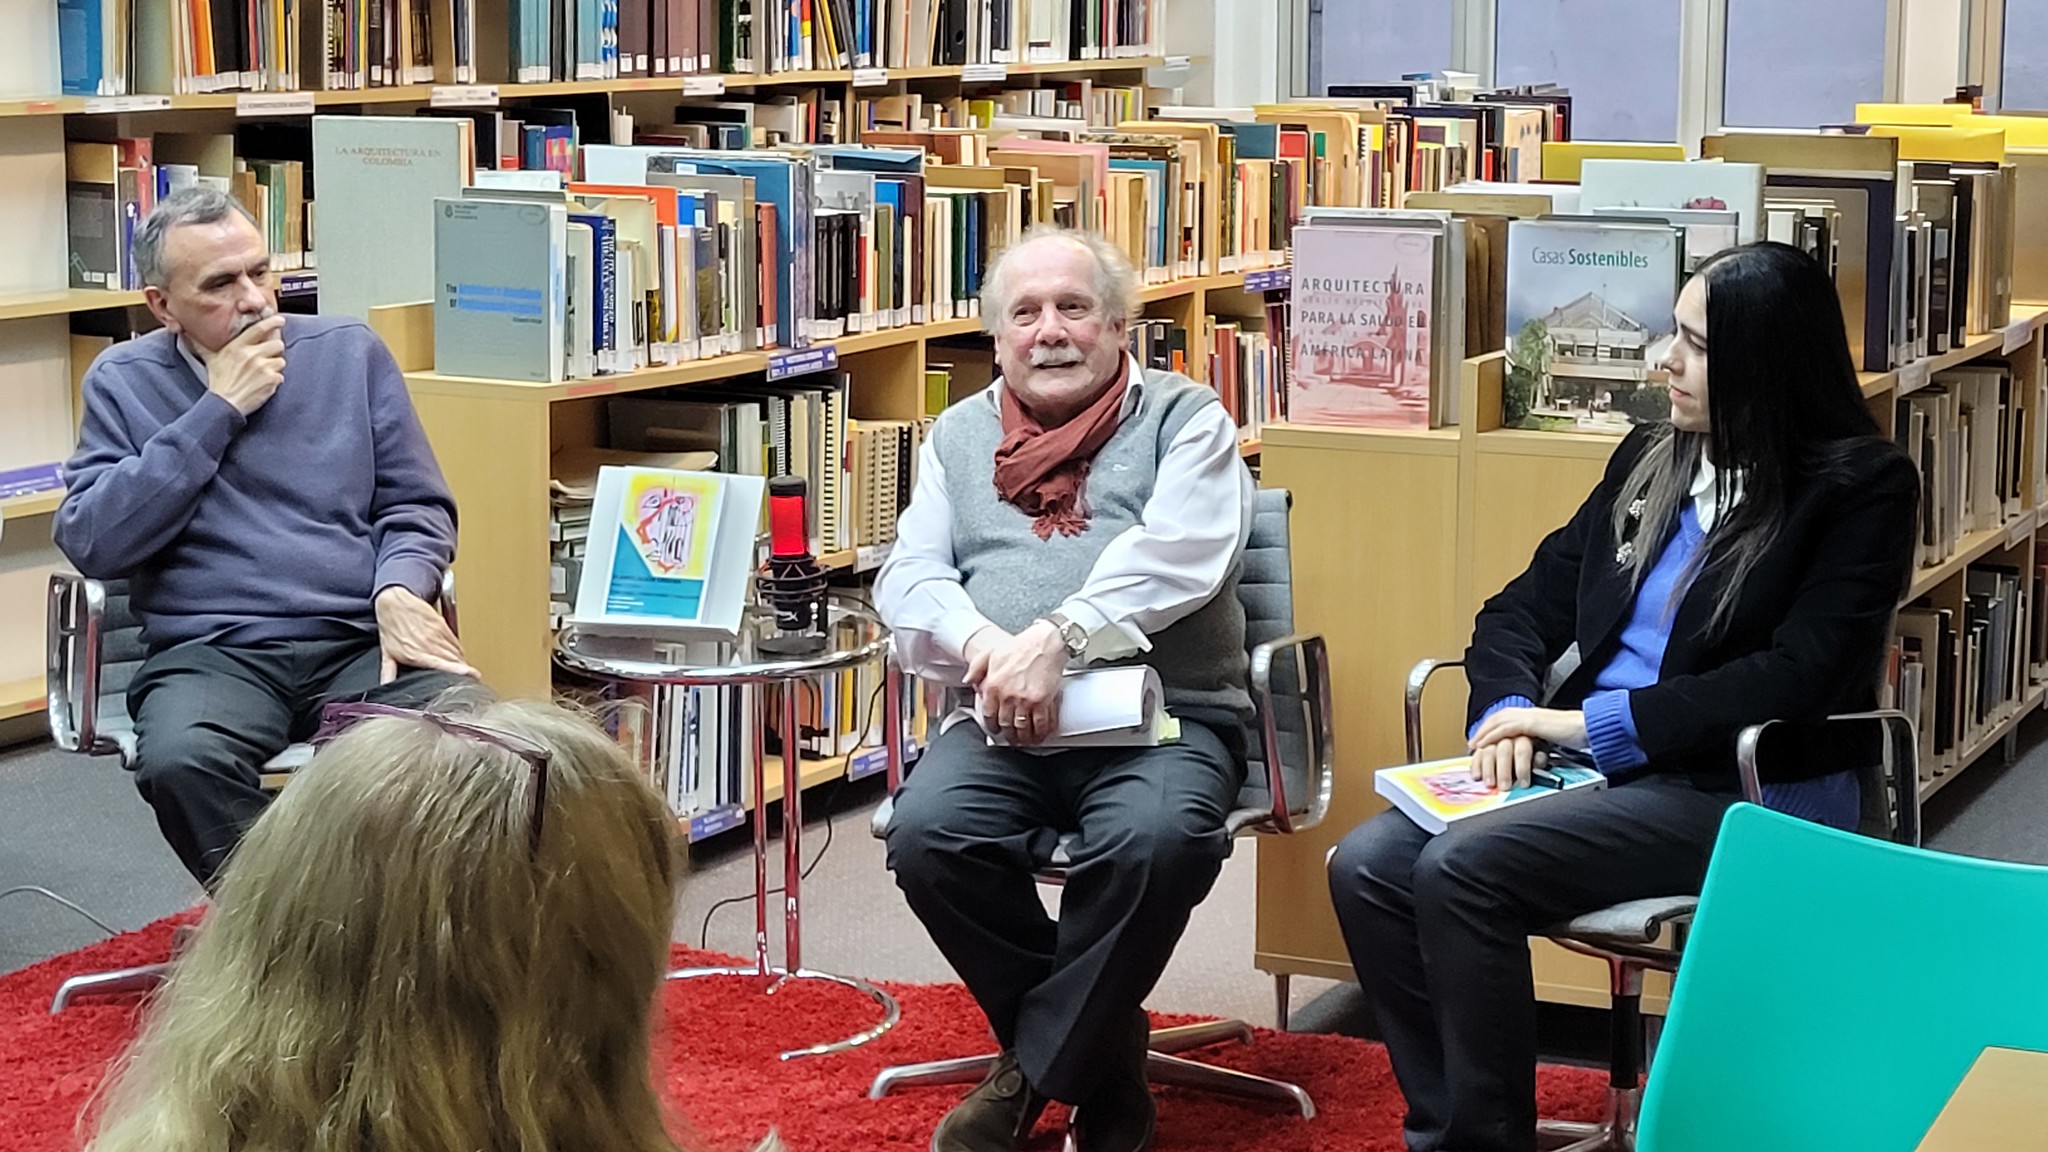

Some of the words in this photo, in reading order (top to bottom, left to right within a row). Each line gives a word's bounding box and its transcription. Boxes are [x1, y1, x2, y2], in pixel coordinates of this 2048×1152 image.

[350, 147, 426, 157] ARQUITECTURA
[362, 156, 413, 166] COLOMBIA
[1532, 246, 1565, 265] Casas
[1568, 248, 1648, 268] Sostenibles
[1301, 278, 1424, 295] ARQUITECTURA
[1301, 310, 1335, 325] PARA
[1340, 312, 1356, 326] LA
[1360, 313, 1403, 327] SALUD
